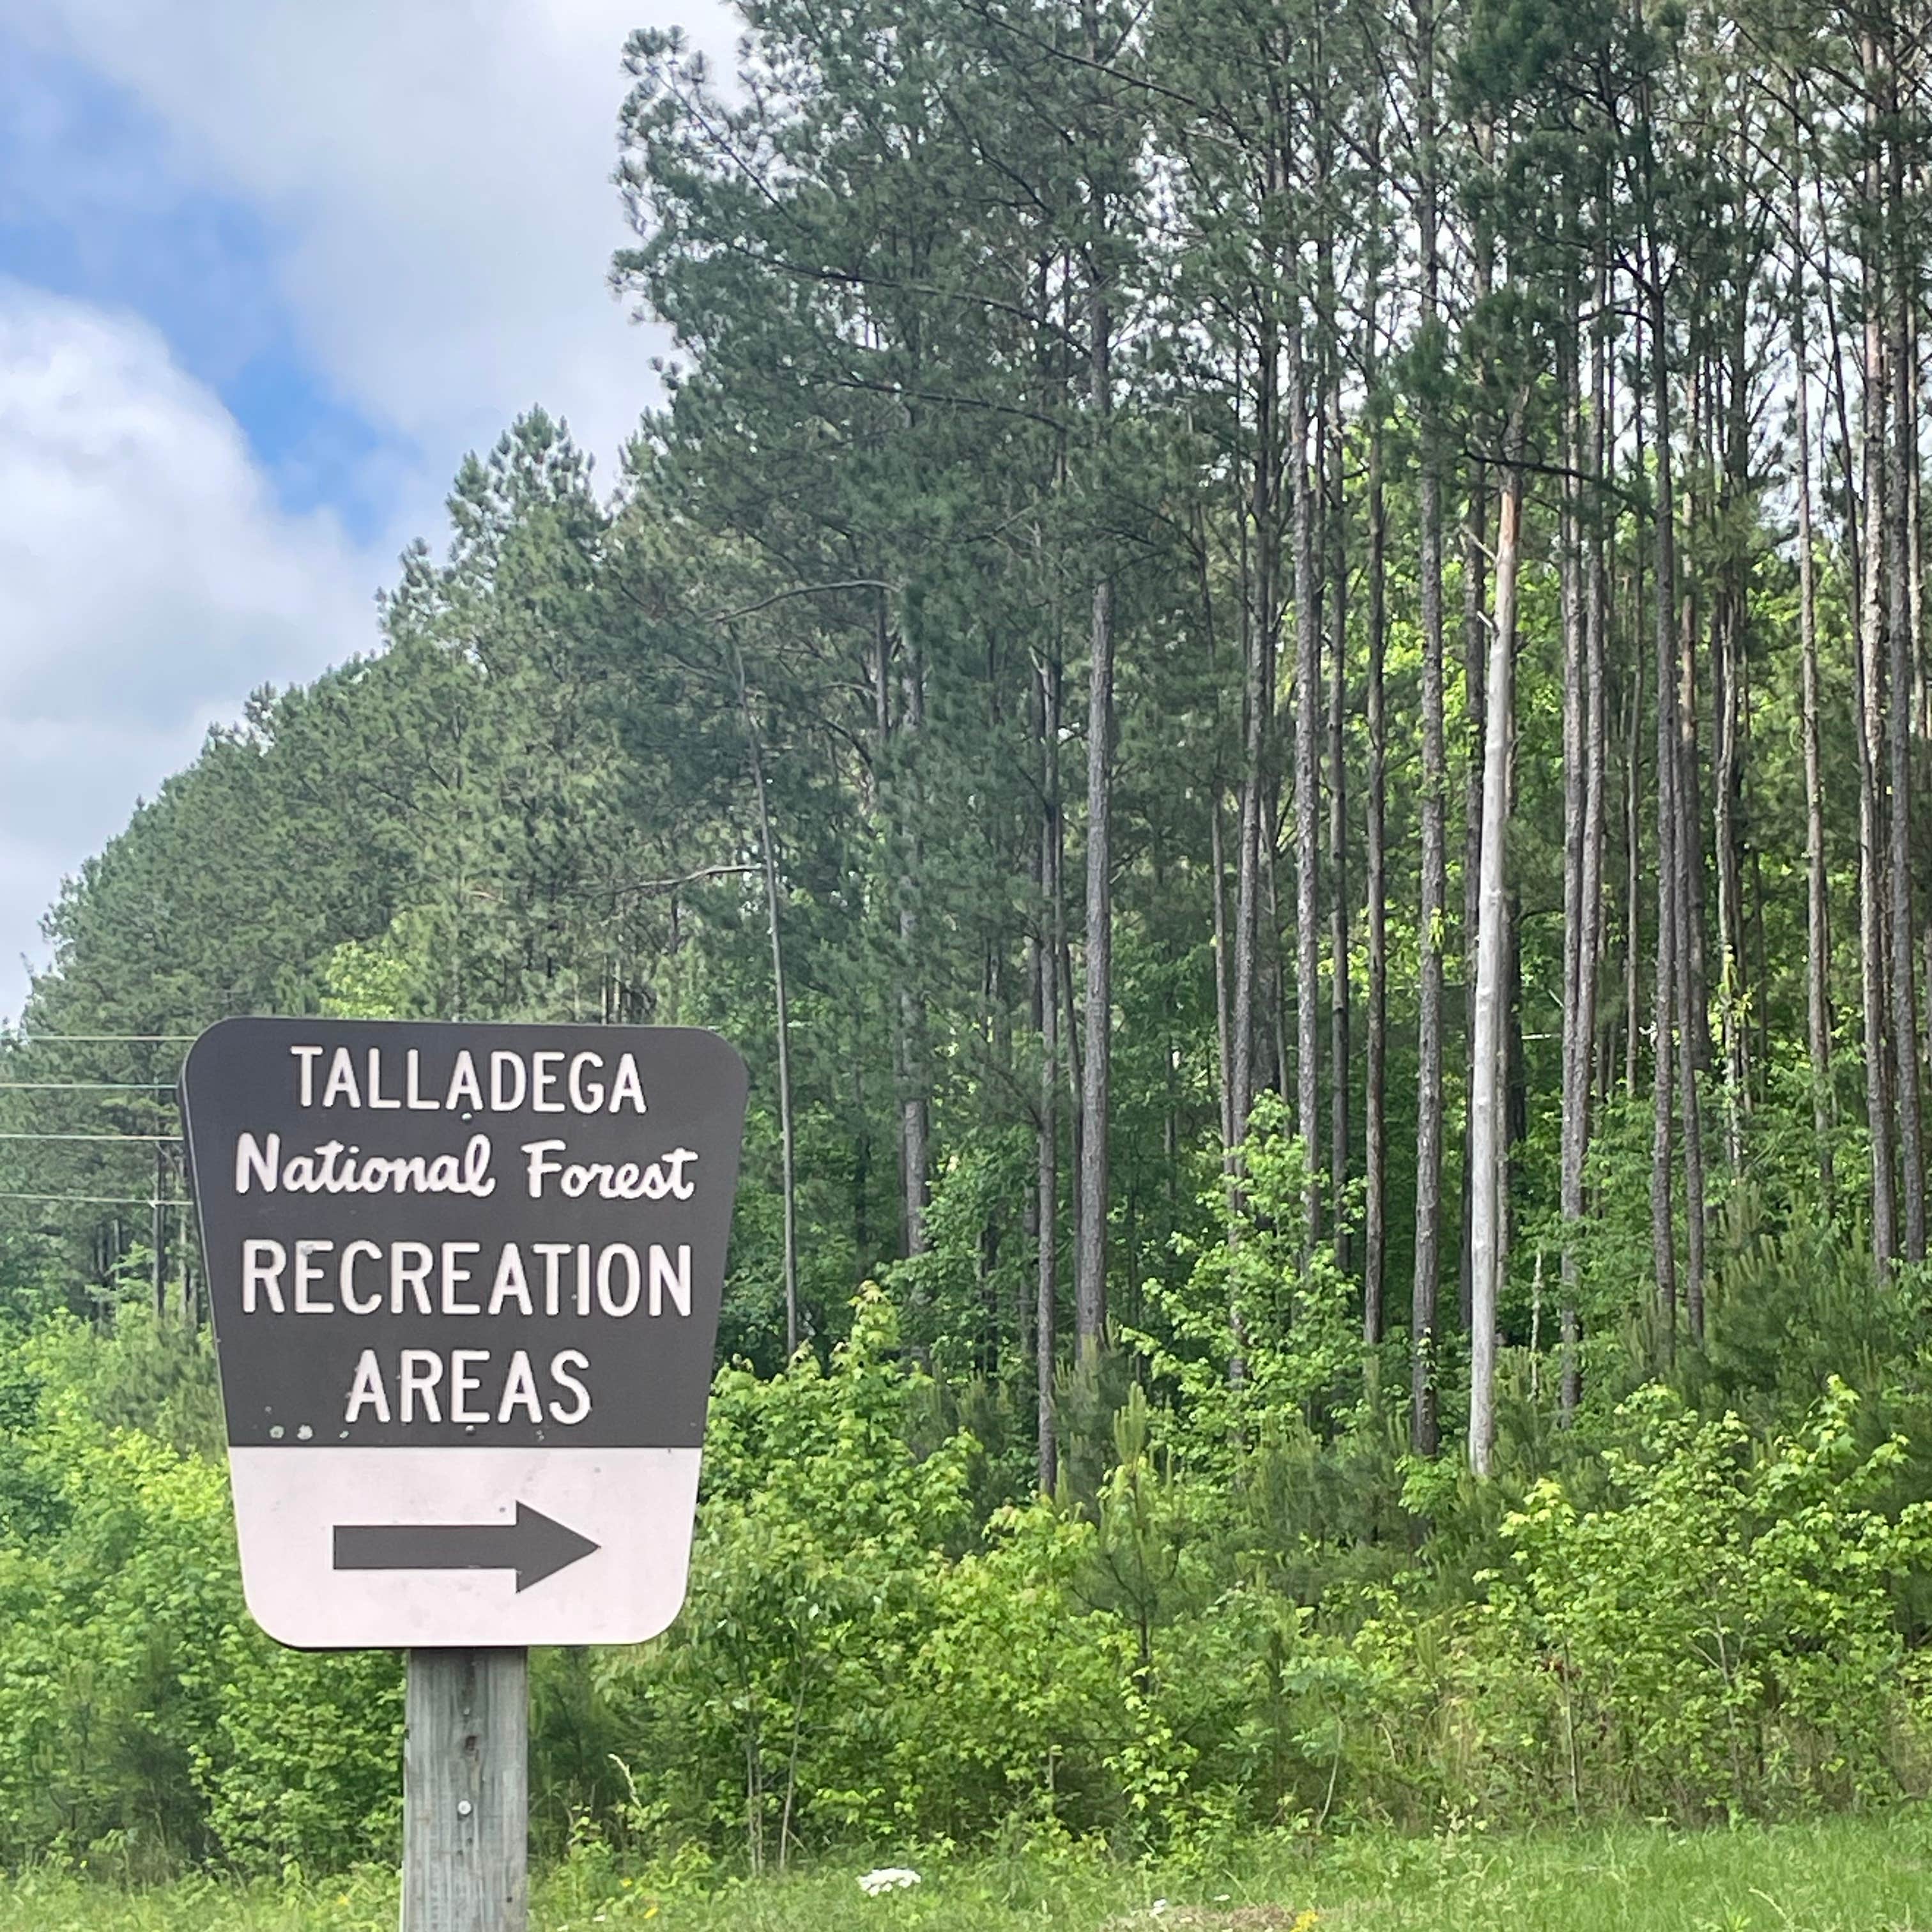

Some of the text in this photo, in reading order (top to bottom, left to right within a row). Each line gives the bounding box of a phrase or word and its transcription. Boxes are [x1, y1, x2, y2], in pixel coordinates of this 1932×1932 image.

[291, 1046, 646, 1113] TALLADEGA
[236, 1133, 698, 1199] National Forest
[243, 1240, 690, 1316] RECREATION
[346, 1350, 591, 1424] AREAS
